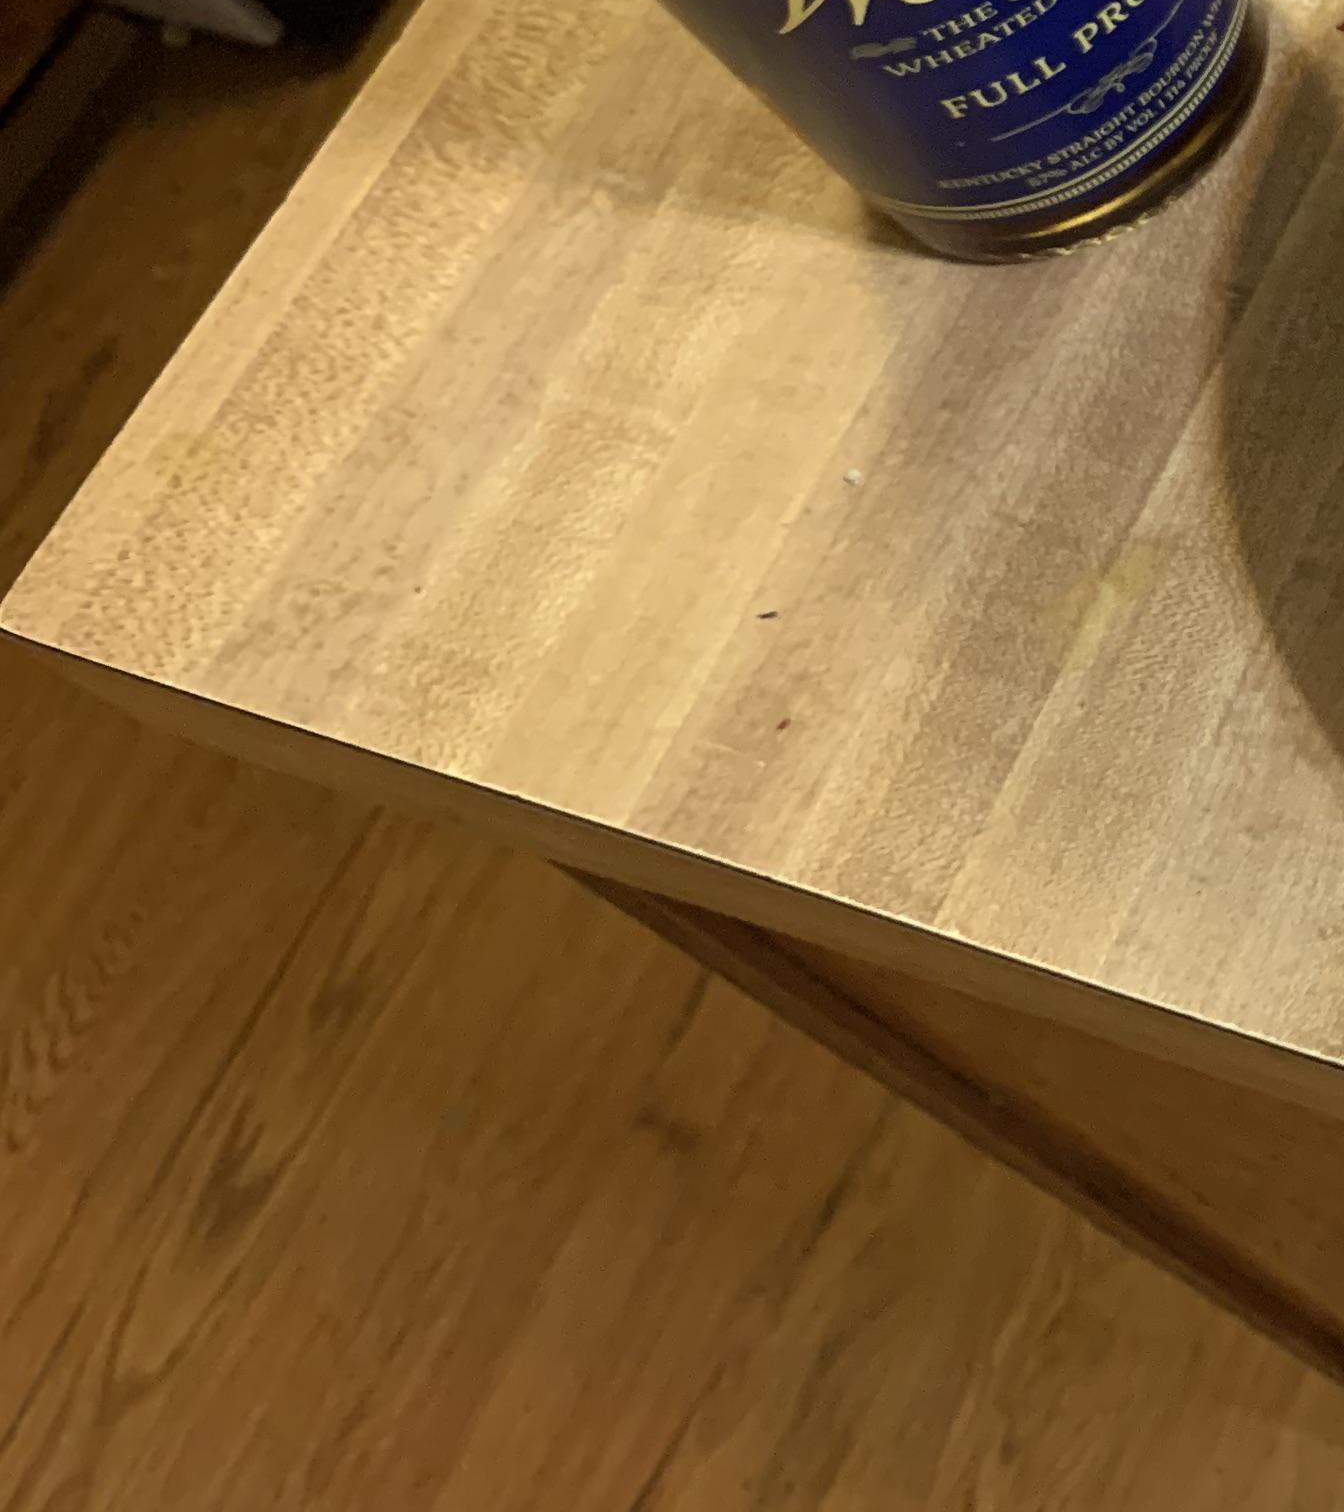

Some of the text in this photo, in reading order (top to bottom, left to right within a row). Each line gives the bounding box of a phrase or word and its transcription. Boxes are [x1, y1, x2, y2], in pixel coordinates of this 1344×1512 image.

[923, 1, 999, 42] THE
[940, 56, 1067, 119] FULL
[1046, 101, 1136, 165] STRAIGHT
[1137, 27, 1205, 104] BOURBON
[1071, 146, 1102, 172] ALC
[1104, 130, 1125, 152] BY
